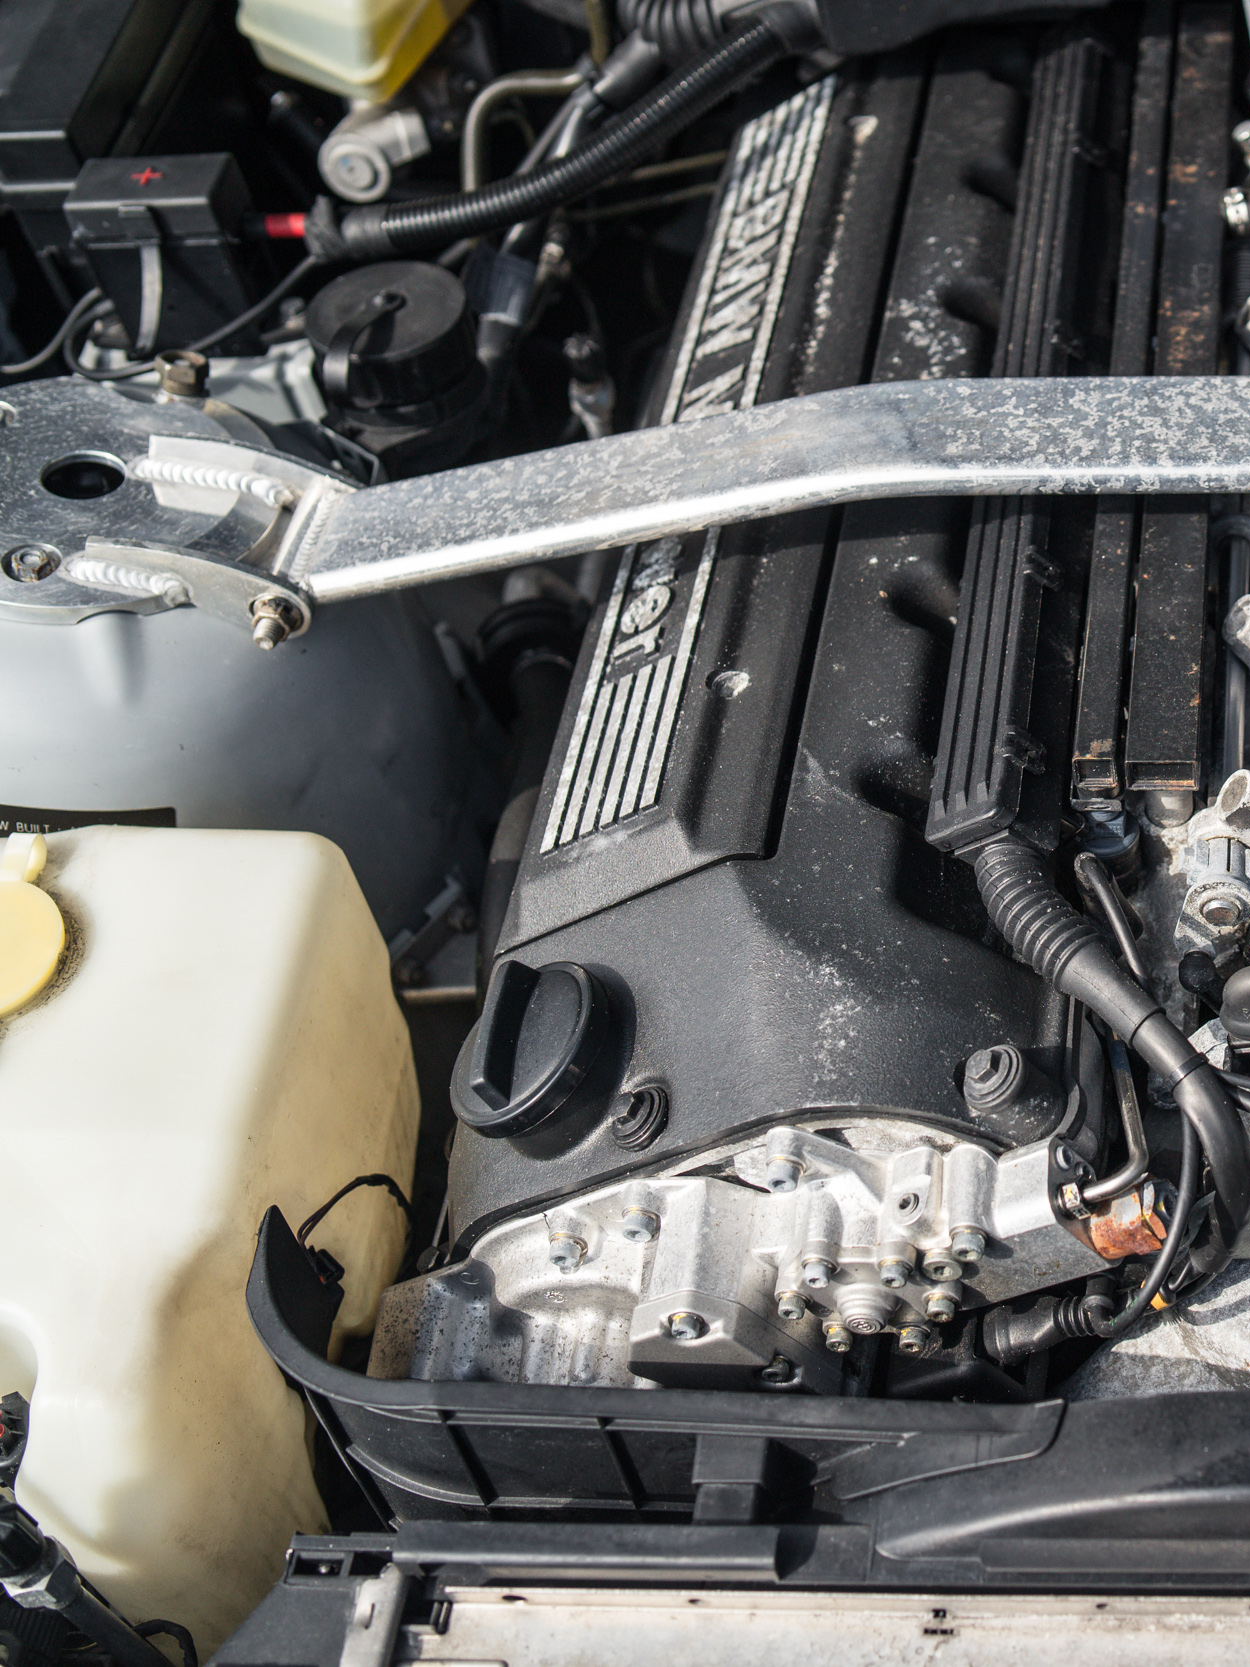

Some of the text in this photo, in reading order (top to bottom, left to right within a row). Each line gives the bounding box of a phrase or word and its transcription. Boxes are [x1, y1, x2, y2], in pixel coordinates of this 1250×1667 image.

[696, 189, 791, 360] BMW
[614, 536, 683, 659] wer
[16, 821, 50, 834] BUILT
